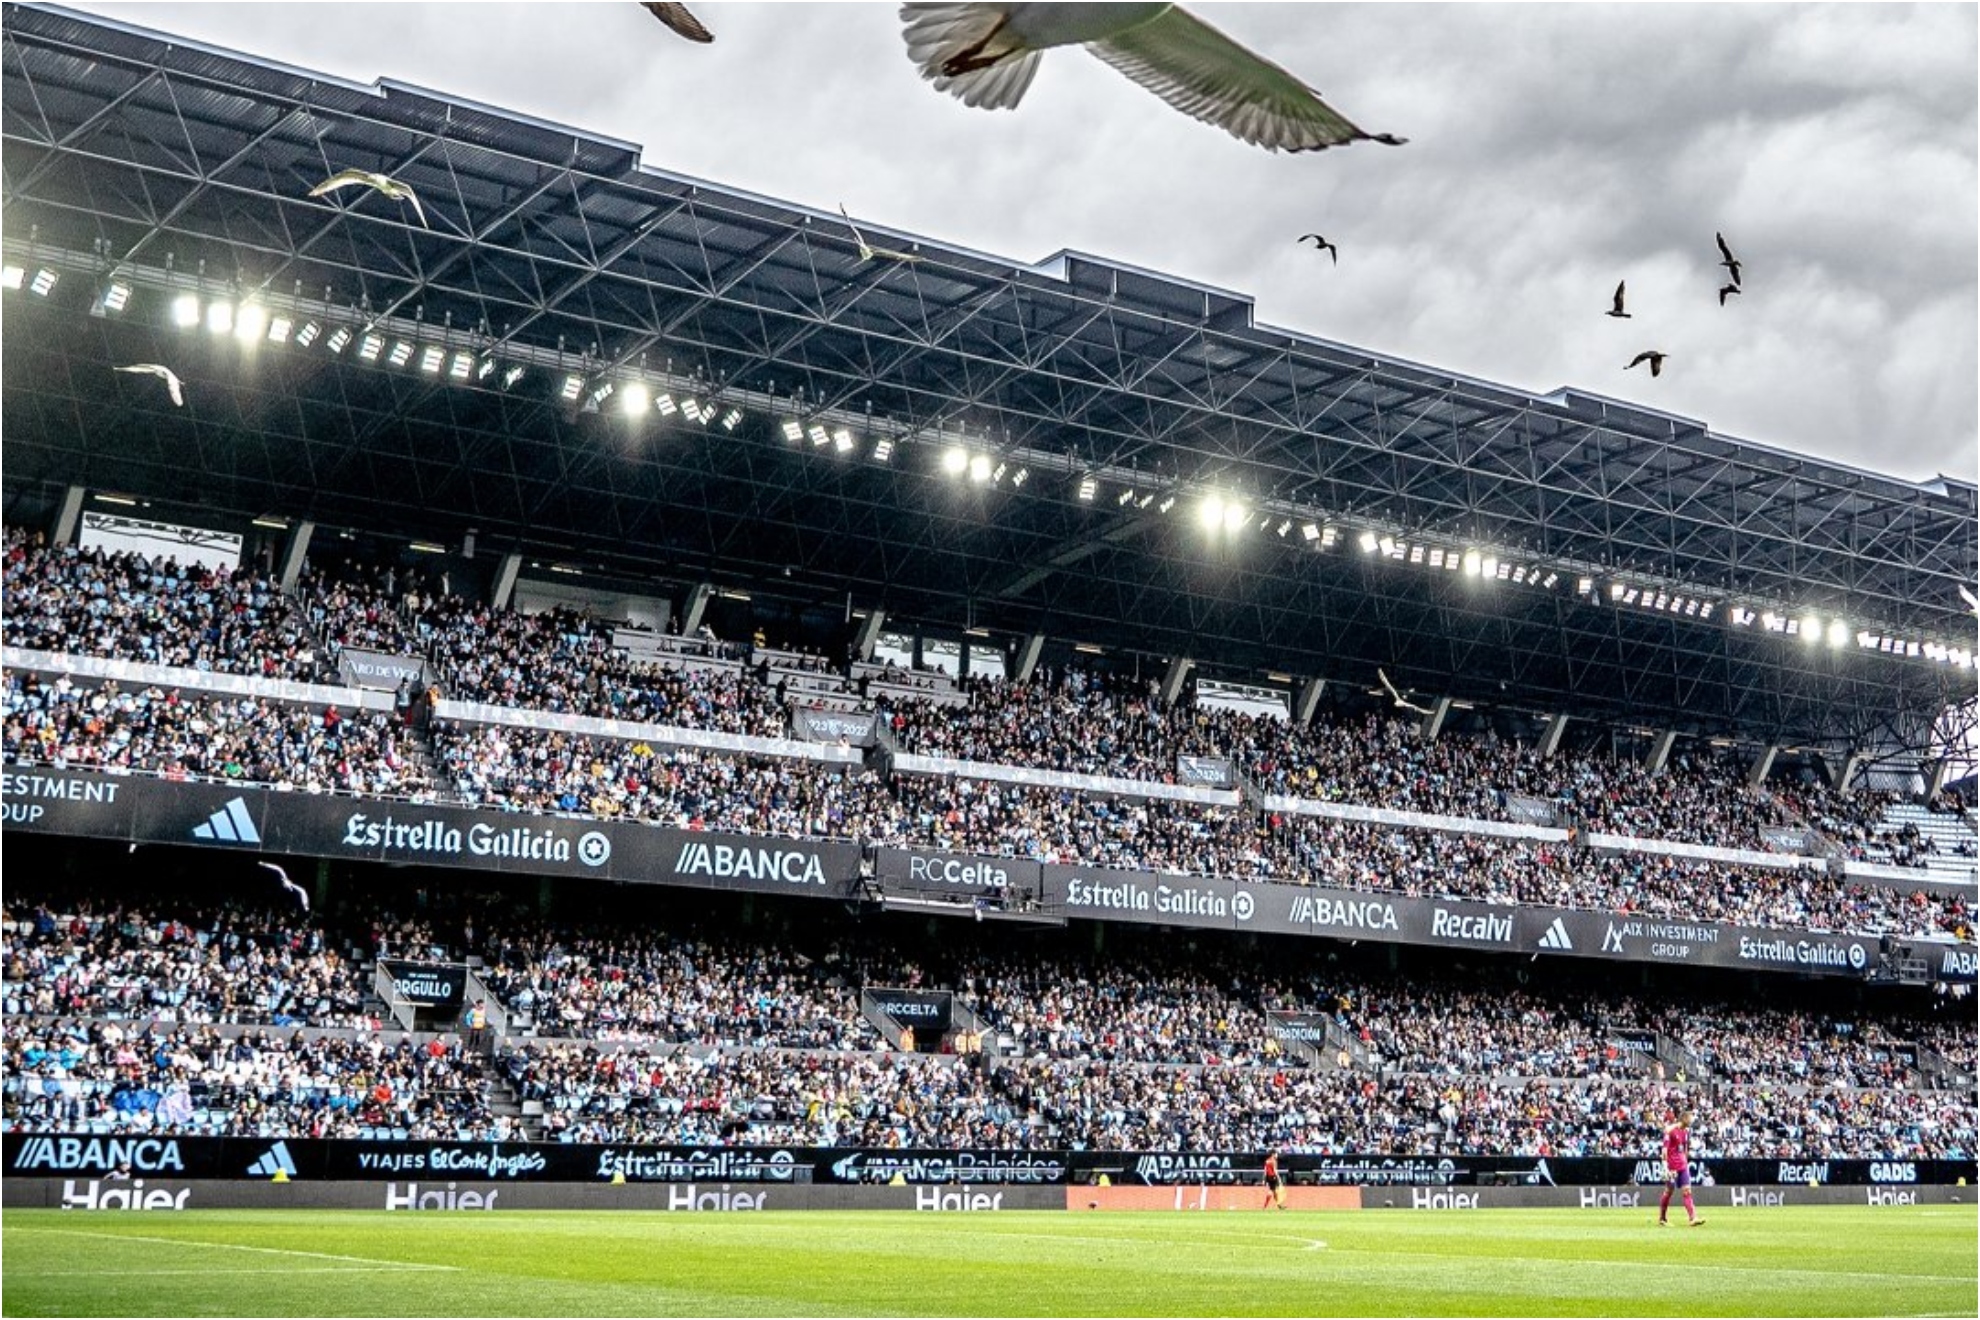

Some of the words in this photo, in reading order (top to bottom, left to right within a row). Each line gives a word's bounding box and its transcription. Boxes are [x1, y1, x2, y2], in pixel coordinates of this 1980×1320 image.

[342, 812, 462, 852] Estrella
[469, 823, 571, 862] Galicia
[1067, 878, 1149, 910] Estrella
[1154, 885, 1227, 917] Galicia
[1431, 908, 1513, 941] Recalvi
[1623, 921, 1643, 936] AIX
[1646, 923, 1719, 943] INVESTMENT
[1652, 943, 1690, 957] GROUP
[1739, 935, 1796, 961] Estrella
[1797, 940, 1847, 965] Galicia
[359, 1153, 426, 1172] VIAJES
[1778, 1162, 1829, 1182] Recalvi
[1870, 1162, 1916, 1182] GADIS
[61, 1178, 191, 1210] Haier
[386, 1181, 498, 1210] Haier
[668, 1183, 767, 1211] Haier
[916, 1185, 1003, 1210] Haier
[1411, 1186, 1480, 1209] Haier
[1579, 1186, 1641, 1208] Haier
[1731, 1186, 1785, 1207] Haier
